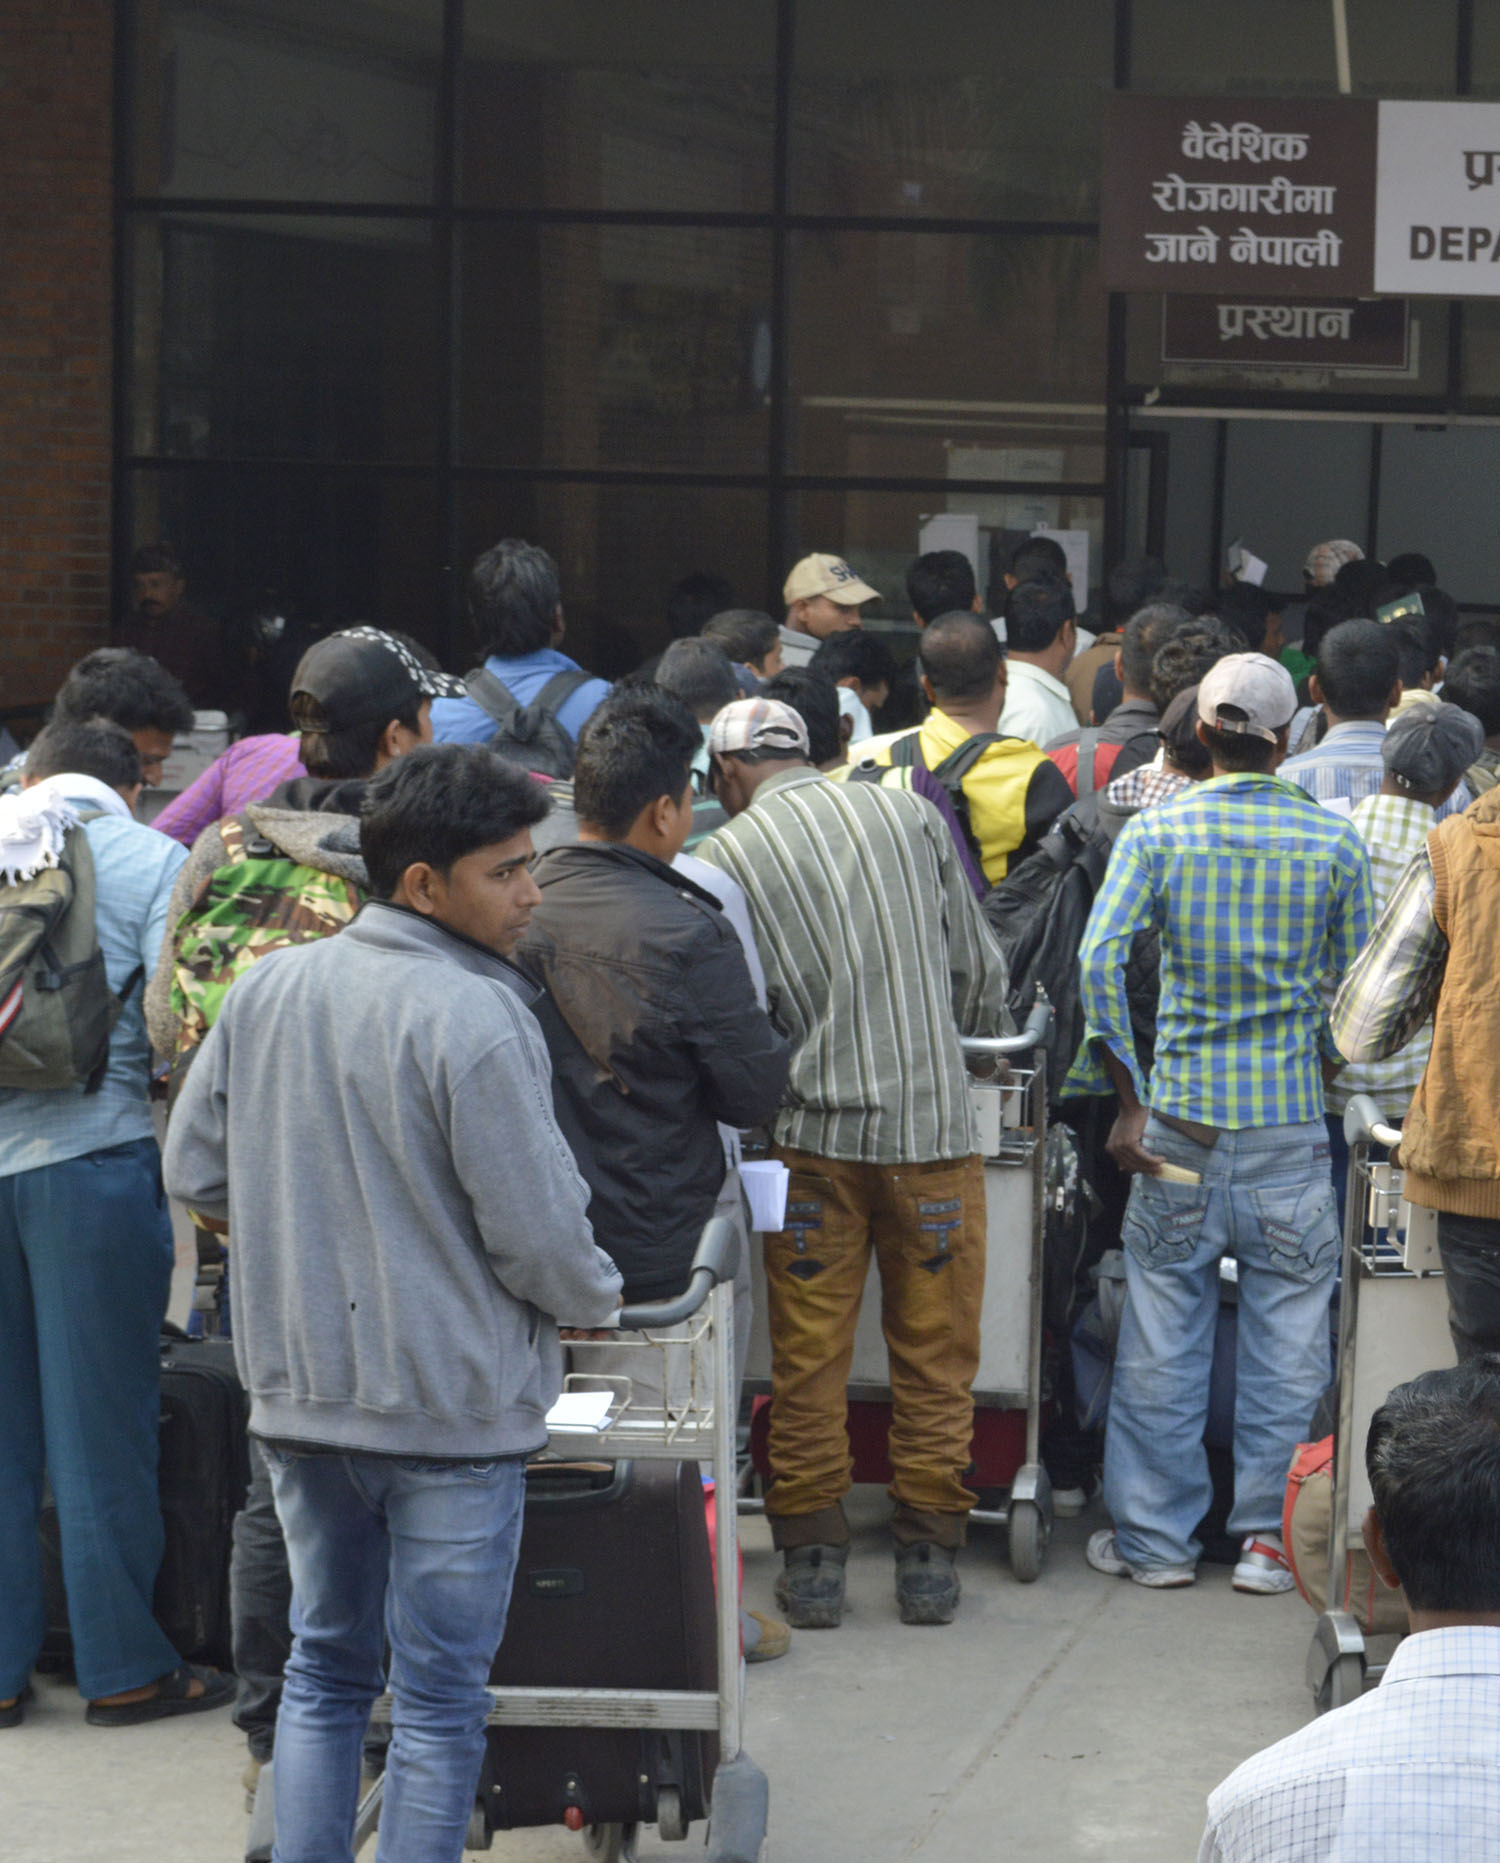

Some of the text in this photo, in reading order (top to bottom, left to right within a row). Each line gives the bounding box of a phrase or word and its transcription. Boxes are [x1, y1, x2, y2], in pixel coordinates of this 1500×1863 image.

[1182, 120, 1310, 163] वैदेशिक
[1152, 173, 1336, 215] रोजगारीमा
[1144, 226, 1342, 267] जाने नेपाली
[1217, 304, 1354, 341] प्रस्थान
